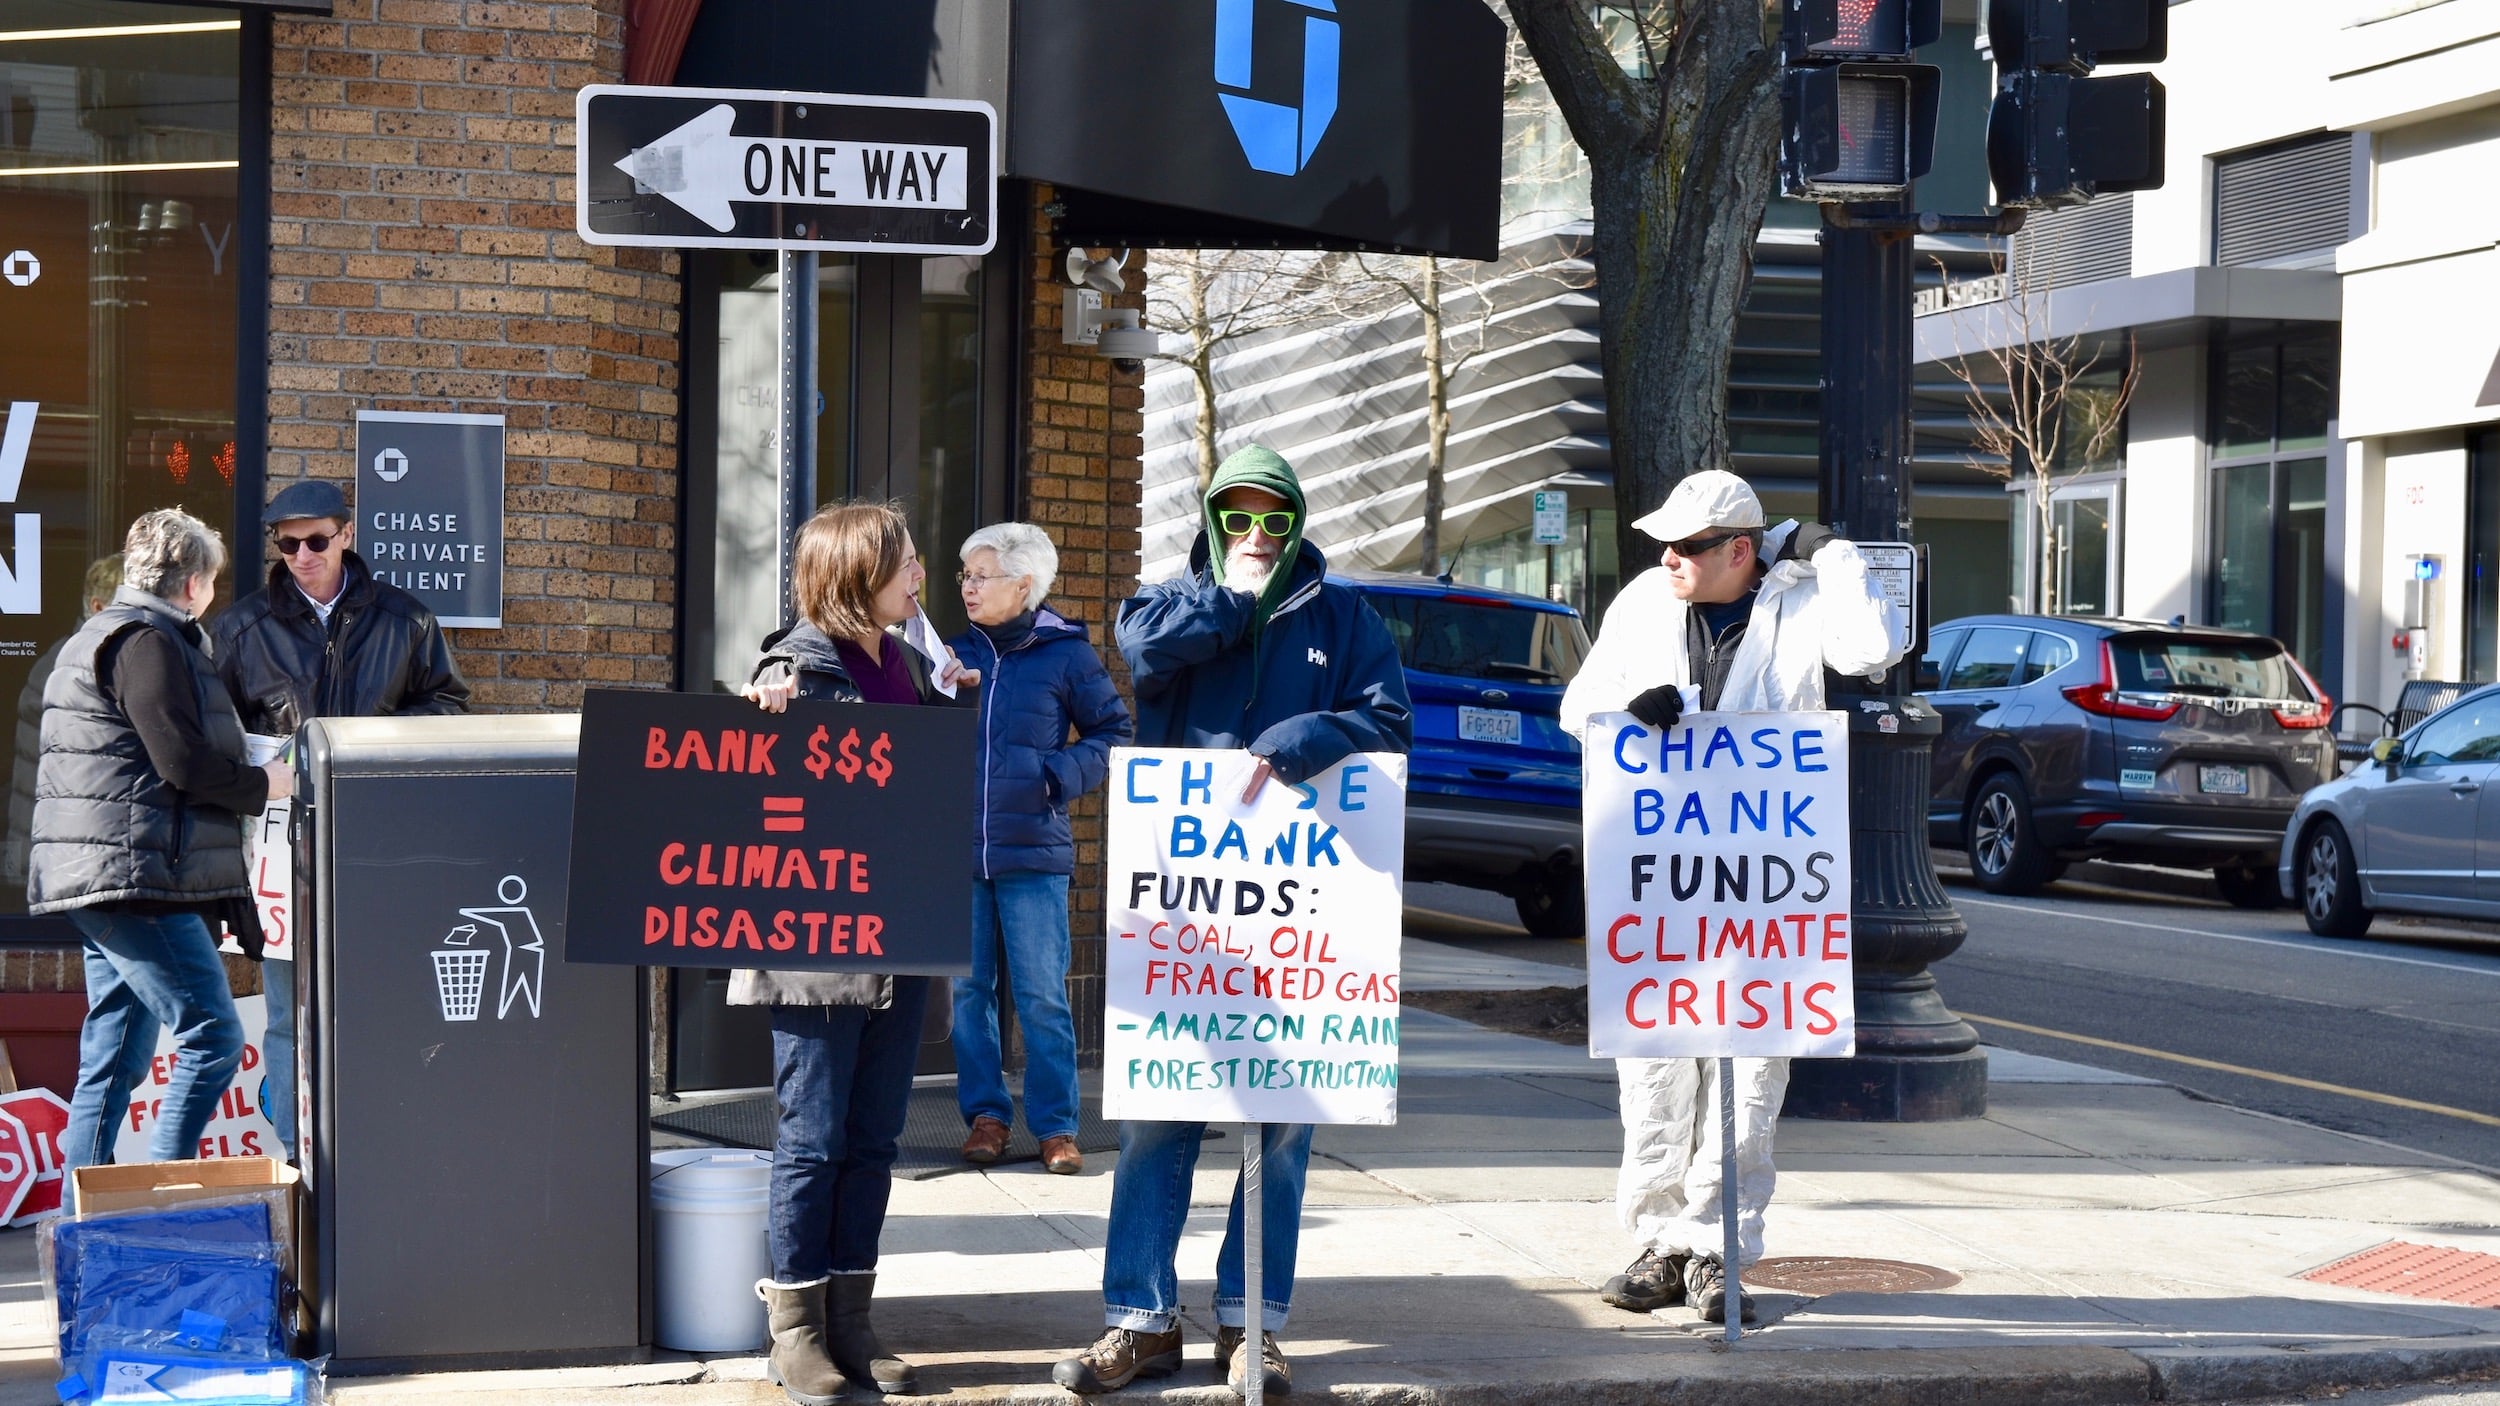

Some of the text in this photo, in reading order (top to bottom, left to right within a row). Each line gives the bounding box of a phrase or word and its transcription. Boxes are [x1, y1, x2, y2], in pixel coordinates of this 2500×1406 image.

[744, 143, 947, 202] ONE WAY
[373, 512, 457, 532] CHASE
[373, 542, 486, 563] PRIVATE
[644, 724, 893, 787] BANK $$$
[1614, 724, 1829, 774] CHASE
[1127, 758, 1368, 811] CHSE
[2123, 772, 2152, 781] WARREN
[1634, 788, 1816, 837] BANK
[1170, 815, 1340, 867] BANK
[659, 842, 869, 893] CLIMATE
[1631, 851, 1834, 903] FUNDS
[1129, 871, 1319, 917] FUNDS:
[644, 905, 884, 955] DISASTER
[1270, 926, 1337, 963] OIL
[1607, 913, 1848, 963] CLIMATE
[1145, 960, 1399, 1003] FRACKED GAS
[1625, 977, 1838, 1036] CRISIS
[1321, 1015, 1400, 1045] RAIN
[1128, 1058, 1399, 1090] FOREST DESTRUCTION
